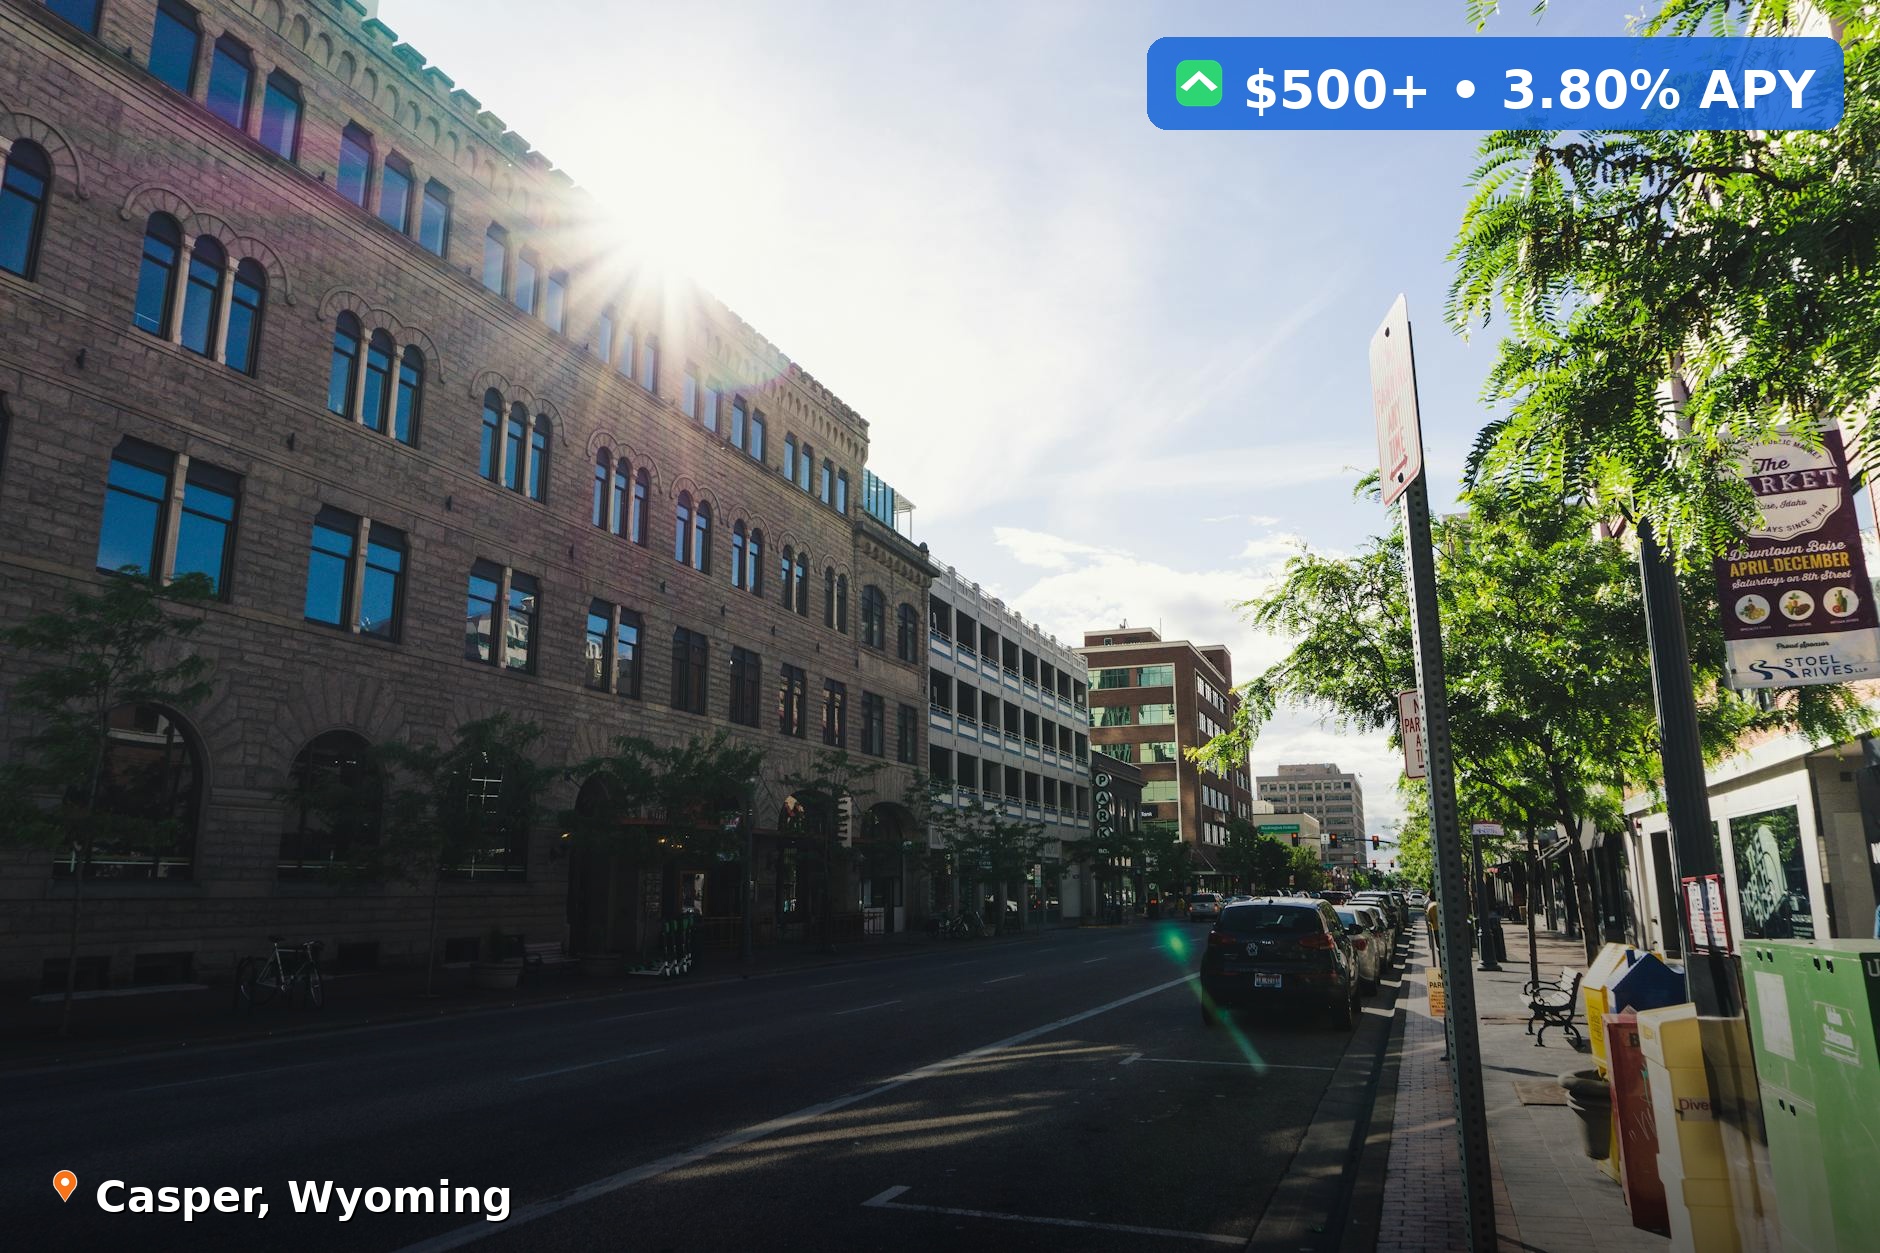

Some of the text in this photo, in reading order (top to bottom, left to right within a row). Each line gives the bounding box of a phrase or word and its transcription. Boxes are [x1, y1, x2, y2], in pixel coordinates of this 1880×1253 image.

[1752, 458, 1790, 472] The
[1757, 468, 1838, 494] RKET
[1780, 499, 1807, 510] Idaho
[1787, 518, 1811, 532] SINCE
[1812, 503, 1828, 520] 1994
[1728, 540, 1846, 561] Downtown Boise
[1729, 551, 1850, 578] APRIL-DECEMBER
[1732, 570, 1852, 590] Saturdays on 8th Street
[1784, 654, 1840, 668] STOEL
[1801, 664, 1854, 678] RIVES
[1096, 774, 1110, 838] PARK
